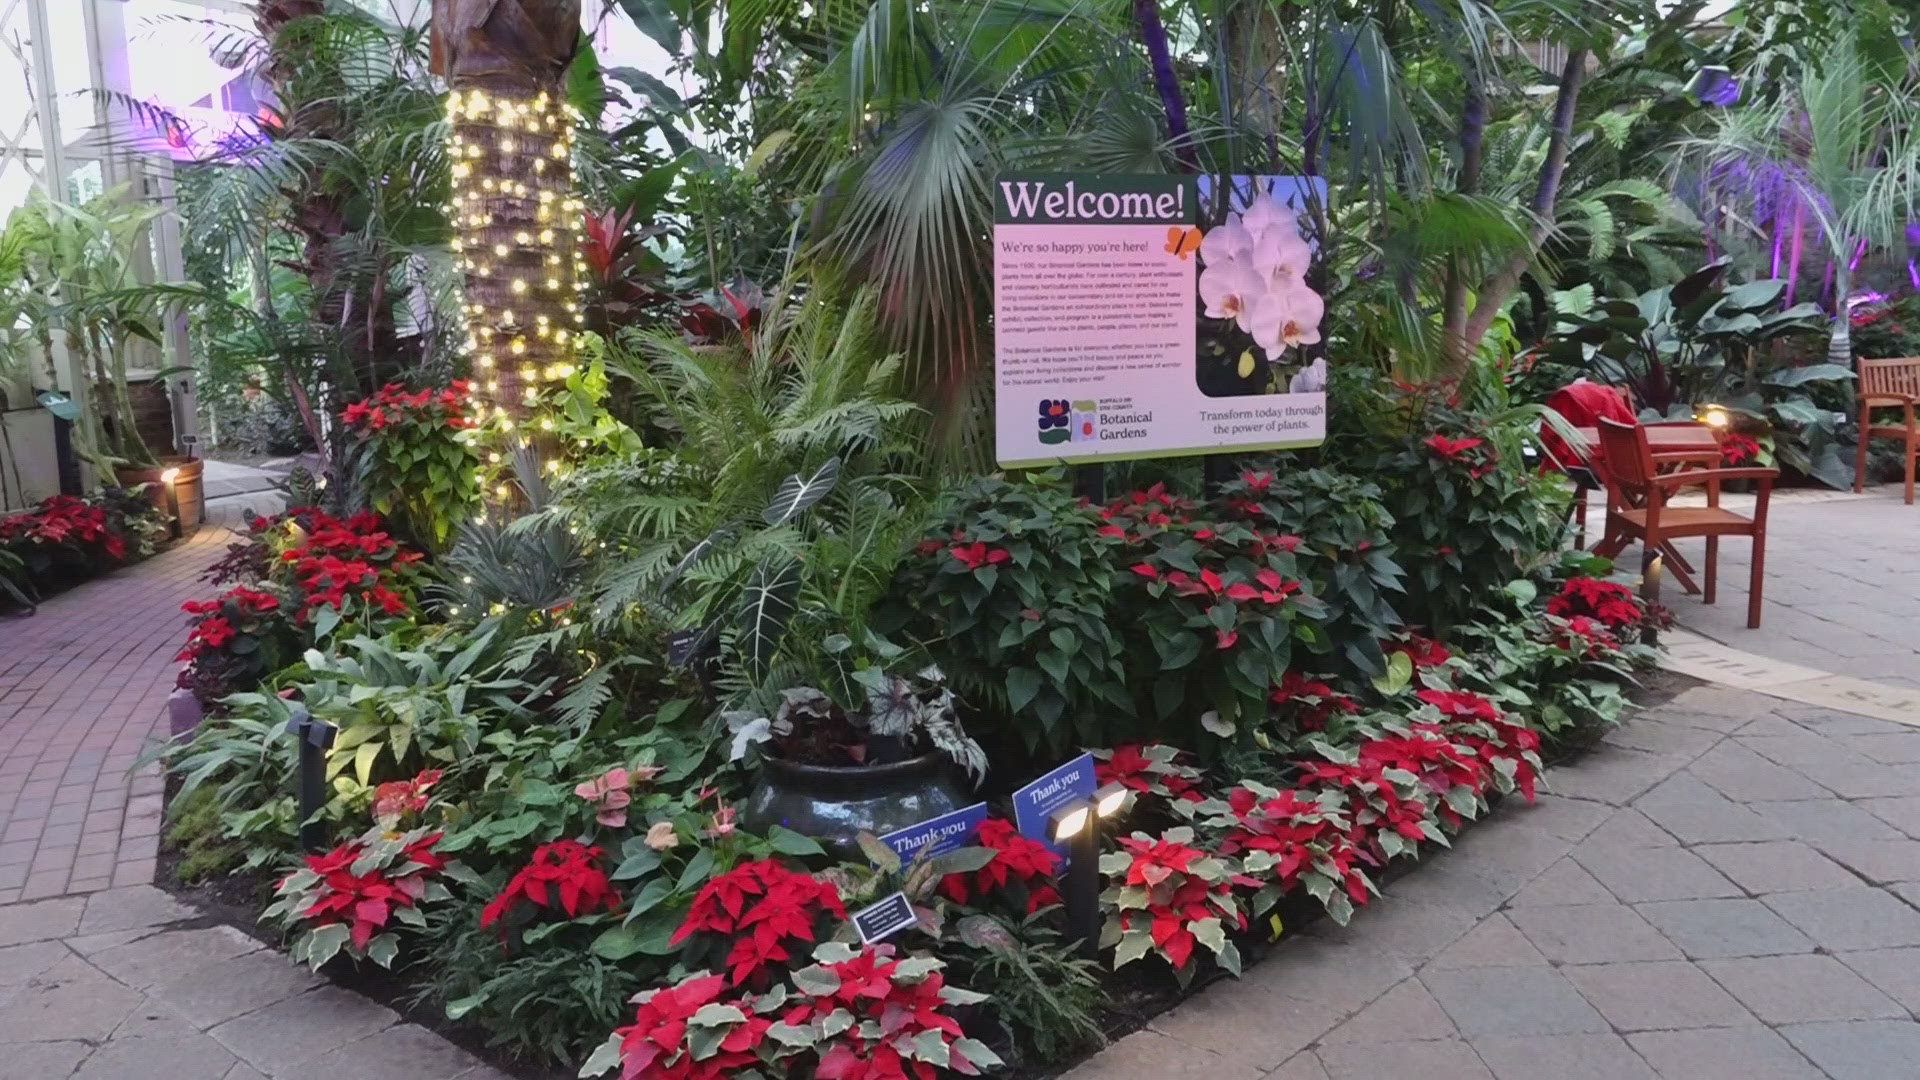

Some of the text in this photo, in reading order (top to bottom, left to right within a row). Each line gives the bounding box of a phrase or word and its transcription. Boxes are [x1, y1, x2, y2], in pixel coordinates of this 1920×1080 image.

[1000, 181, 1184, 219] Welcome!
[1002, 242, 1034, 252] We're
[1052, 241, 1084, 254] happy
[1088, 242, 1120, 254] you're
[1123, 241, 1148, 252] here!
[1100, 411, 1152, 425] Botanical
[1200, 406, 1323, 422] Transform today through
[1100, 428, 1147, 440] Gardens
[1214, 420, 1310, 436] the power of plants.
[1030, 778, 1061, 804] Thank
[1062, 770, 1080, 790] you
[894, 828, 938, 853] Thank
[940, 821, 966, 841] you
